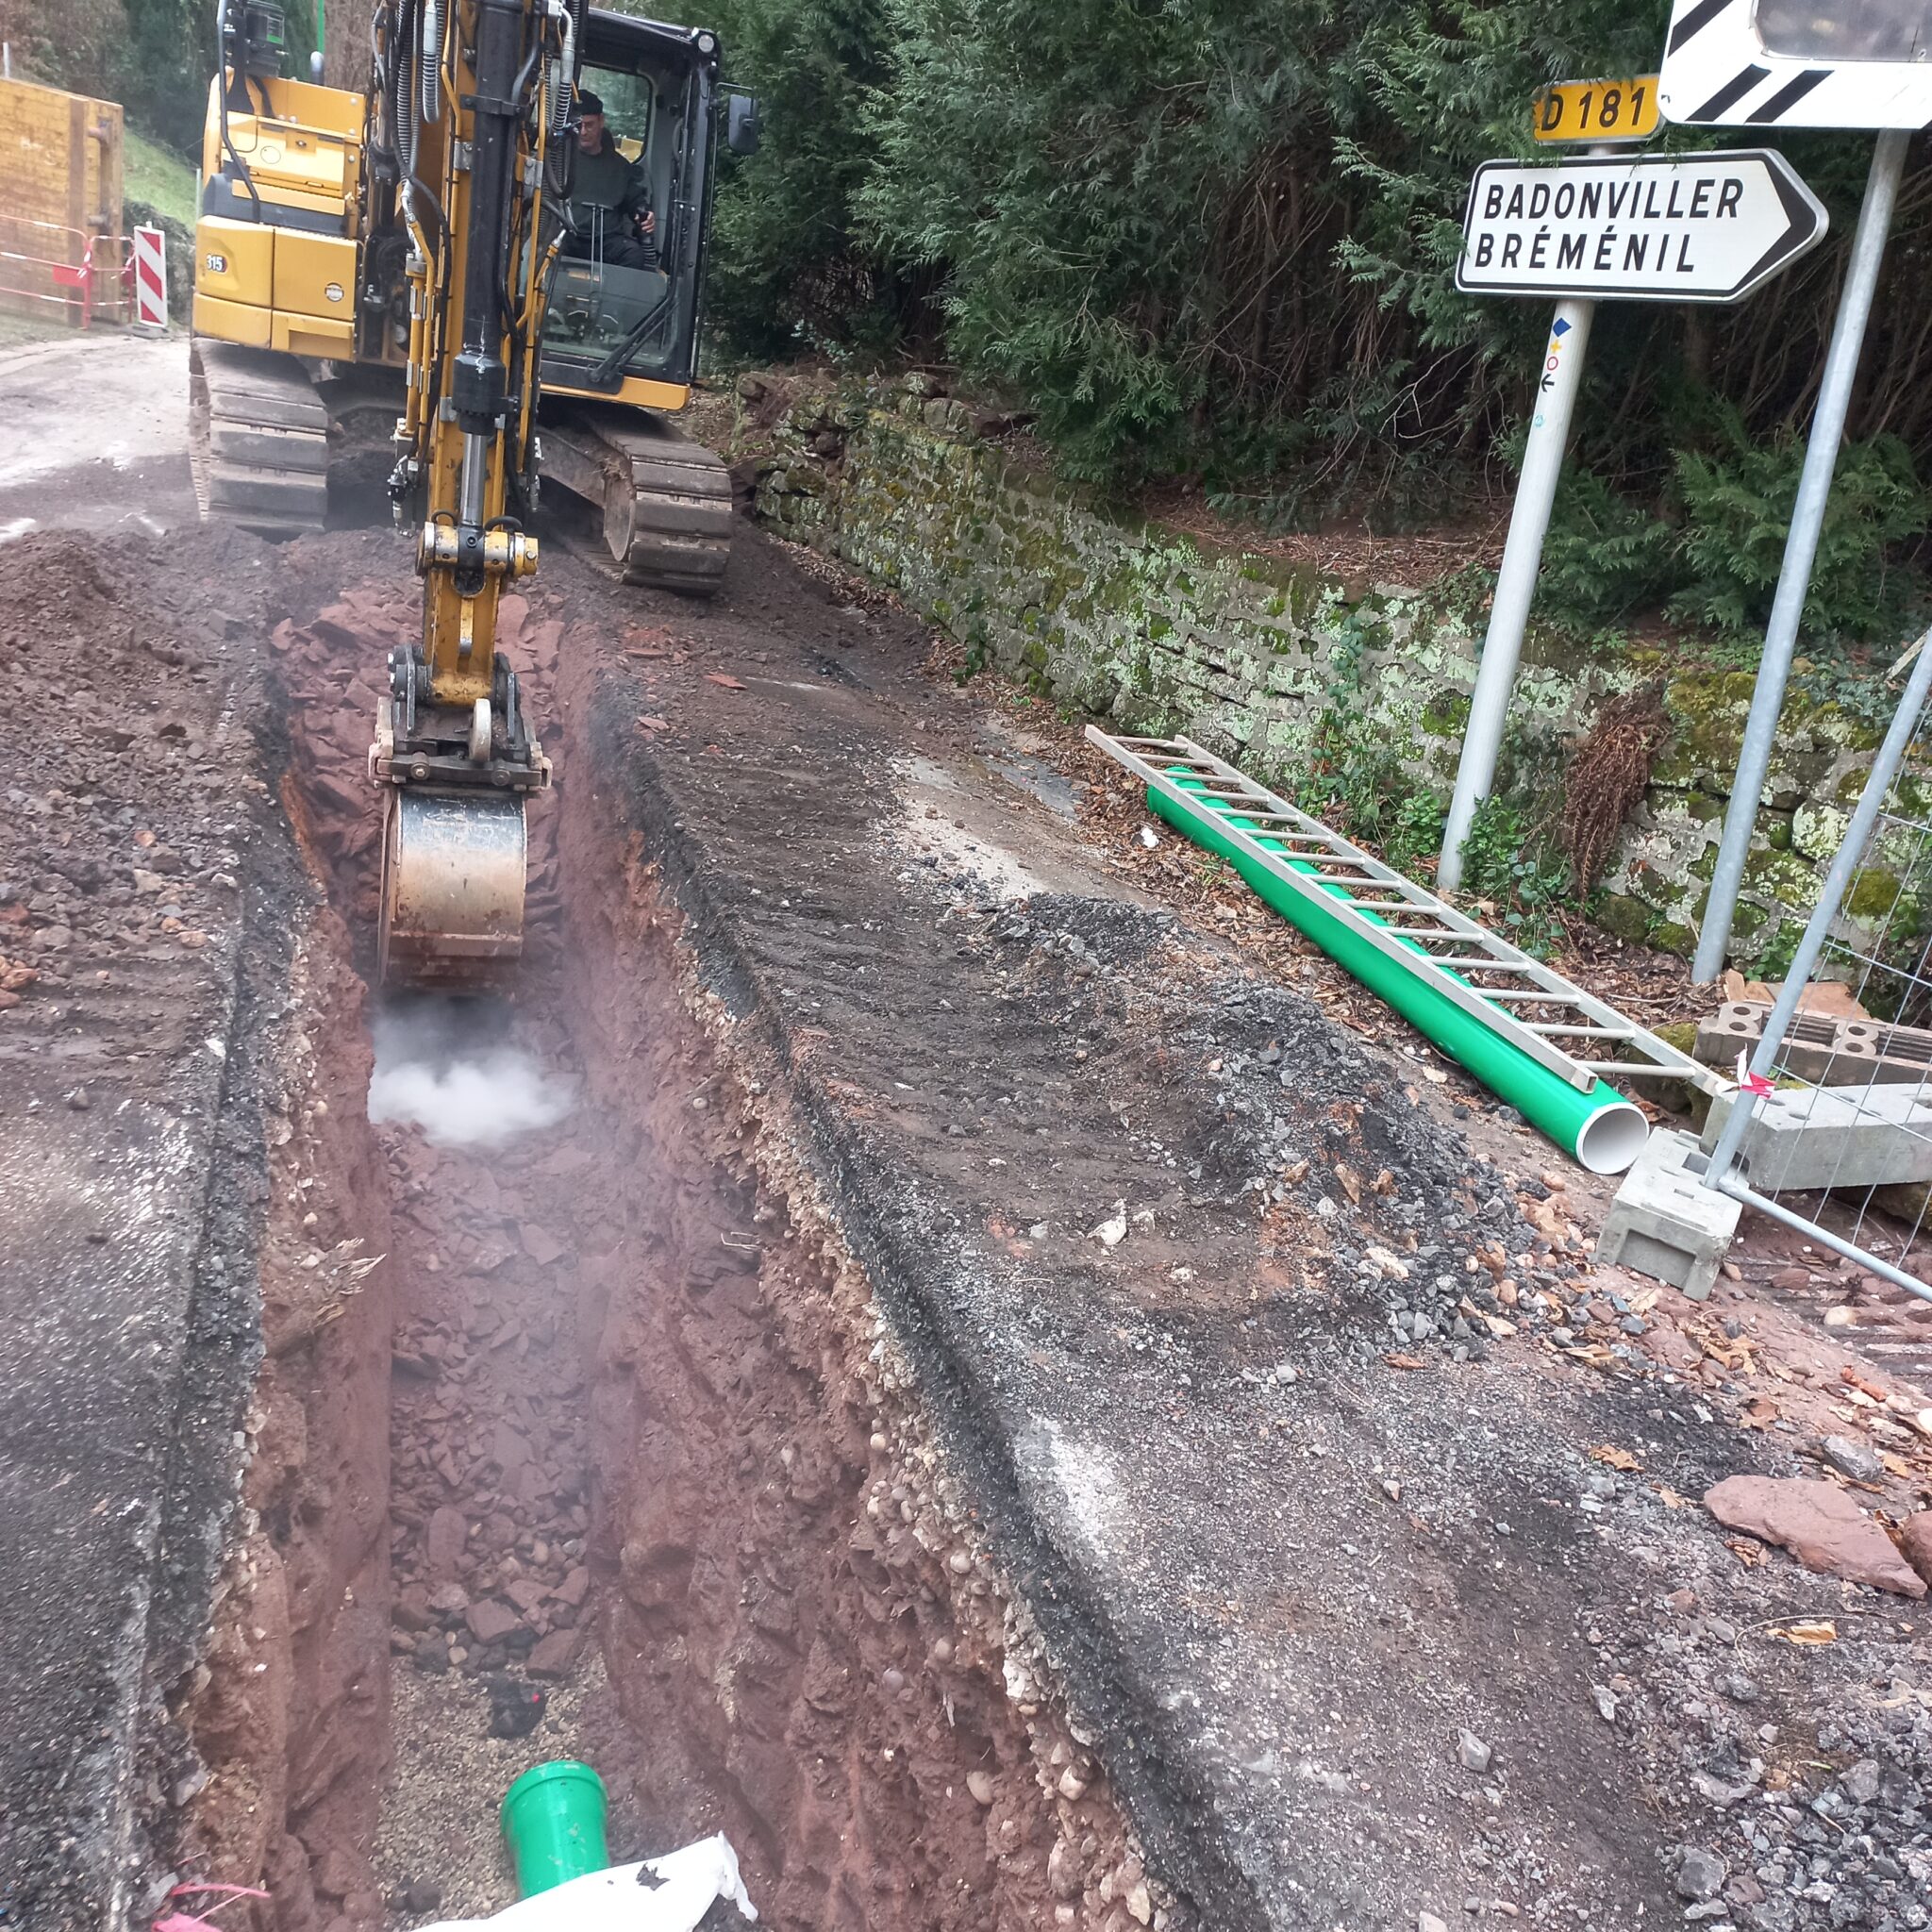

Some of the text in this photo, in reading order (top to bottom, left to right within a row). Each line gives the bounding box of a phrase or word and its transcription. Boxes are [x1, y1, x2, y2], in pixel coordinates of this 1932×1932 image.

[1541, 86, 1646, 131] D 181
[1484, 178, 1744, 219] BADONVILLER
[206, 254, 224, 272] 315
[1474, 225, 1695, 273] BRÉMÉNIL
